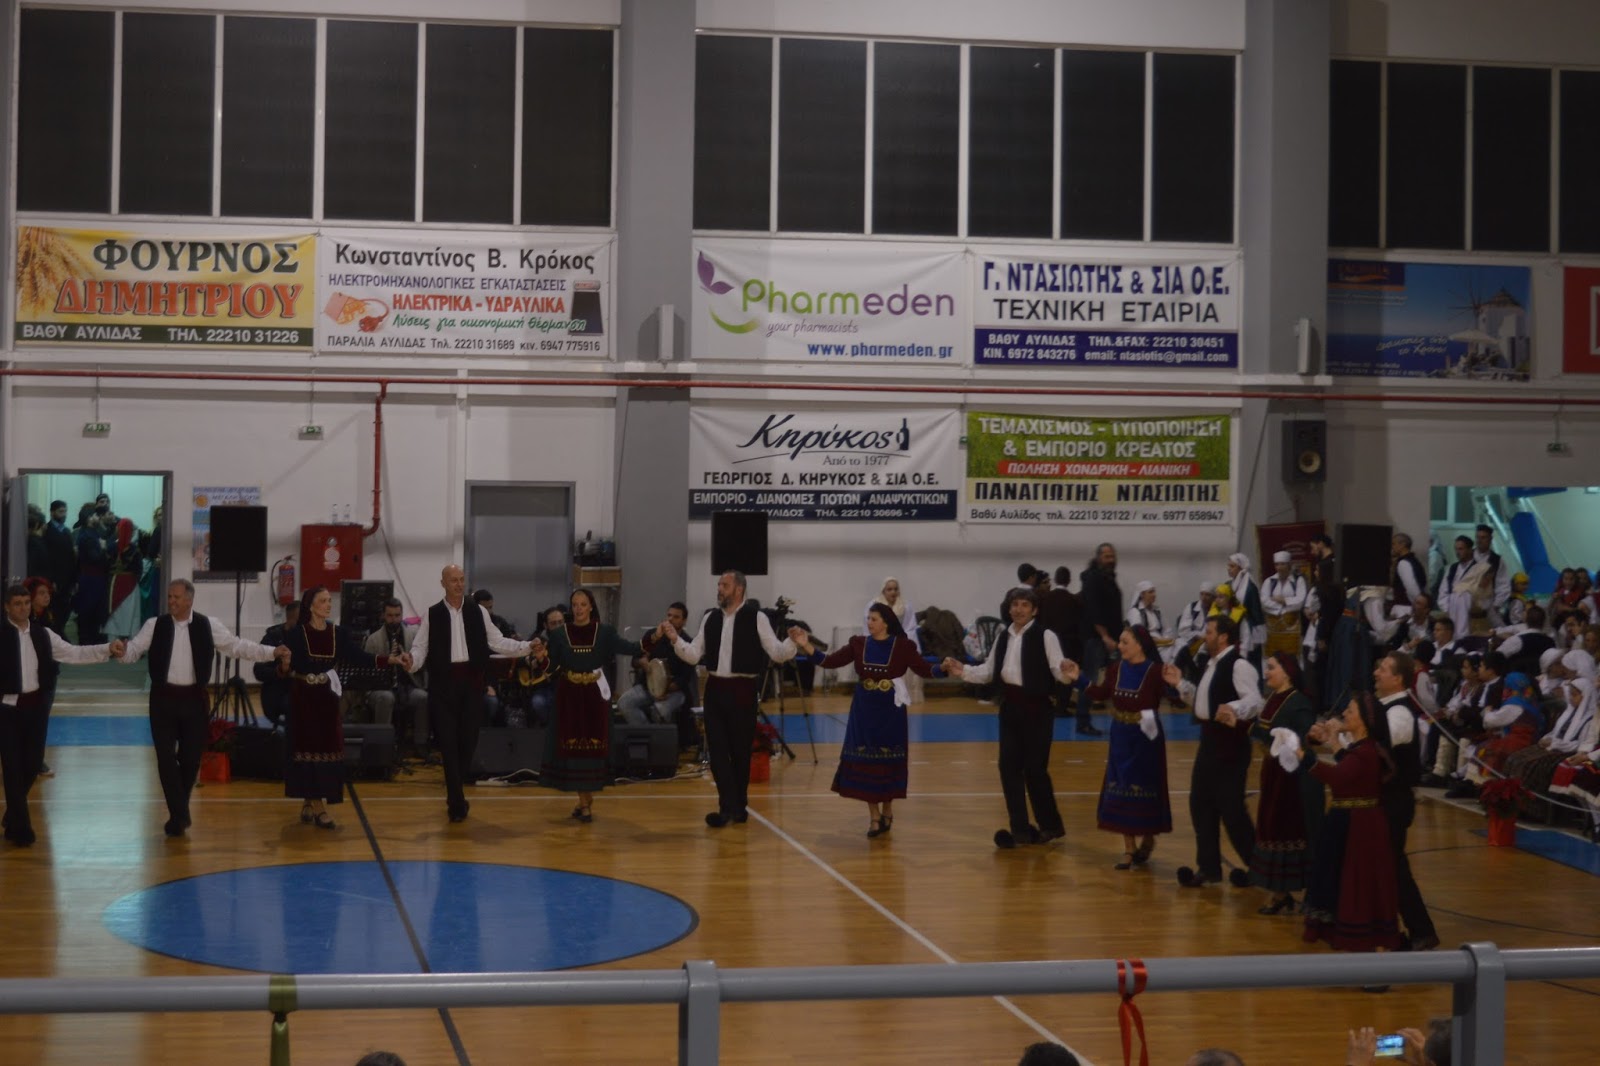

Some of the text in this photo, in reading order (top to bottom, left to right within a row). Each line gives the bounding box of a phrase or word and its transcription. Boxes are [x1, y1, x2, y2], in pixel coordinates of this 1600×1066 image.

[92, 238, 300, 274] ΦΟΥΡΝΟΣ
[335, 243, 595, 274] Κωνσταντίνος Β. Κρόκος
[328, 274, 476, 290] ΗΛΕΚΤΡΟΜΗΧΑΝΟΛΟΓΙΚΕΣ
[481, 278, 567, 291] ΕΓΚΑΤΑΣΤΑΣΕΙΣ
[983, 261, 1230, 295] Γ. ΝΤΑΣΙΩΤΗΣ & ΣΙΑ Ο.Ε.
[54, 277, 304, 318] ΔΗΜΗΤΡΙΟΥ
[393, 294, 473, 312] ΗΛΕΚΤΡΙΚΑ
[486, 296, 565, 313] ΥΔΡΑΥΛΙΚΑ
[742, 278, 955, 316] Pharmeden
[993, 298, 1219, 323] ΤΕΧΝΙΚΗ ΕΤΑΙΡΙΑ
[392, 314, 431, 329] Λύσεις
[437, 316, 457, 331] για
[461, 317, 525, 332] οικονομική
[765, 320, 859, 337] your pharmacists
[22, 324, 300, 343] ΒΑΘΥ ΑΥΛΙΔΑΣ ΤΗΛ. 22210 31226
[988, 334, 1020, 345] ΒΑΘΥ
[1025, 335, 1076, 346] ΑΥΛΙΔΑΣ
[1152, 337, 1187, 347] 22210
[1190, 337, 1224, 348] 30451
[327, 335, 600, 351] ΠΑΡΑΛΙΑ ΑΥΛΙΔΑΣ Τηλ. 22210 31689 κιν. 6947 775916
[807, 343, 954, 358] www.pharmeden.gr
[983, 349, 1076, 360] ΚΙΝ. 6972 843276
[1085, 351, 1229, 362] email: ntasiotis@gmail.com
[979, 418, 1094, 436] ΤΕΜΑΧΙΣΜΟΣ
[1112, 420, 1222, 436] ΤΥΠΟΠΟΙΗΣΗ
[736, 414, 894, 460] Κηρύκος
[1003, 440, 1197, 458] & ΕΜΠΟΡΙΟ ΚΡΕΑΤΟΣ
[822, 456, 847, 466] Από
[864, 456, 890, 466] 1977
[1008, 463, 1060, 475] ΠΩΛΗΣΗ
[1064, 464, 1128, 475] ΧΟΝΔΡΙΚΗ
[1139, 465, 1191, 476] ΛΙΑΝΙΚΗ
[704, 472, 939, 485] ΓΕΩΡΓΙΟΣ Δ. ΚΗΡΥΚΟΣ & ΣΙΑ Ο.Ε.
[693, 492, 747, 504] ΕΜΠΟΡΙΟ
[755, 493, 815, 505] ΔΙΑΝΟΜΕΣ
[820, 493, 860, 505] ΠΟΤΩΝ
[868, 494, 948, 505] ΑΝΑΨΥΚΤΙΚΩΝ
[975, 482, 1220, 502] ΠΑΝΑΓΙΩΤΗΣ ΝΤΑΣΙΩΤΗΣ
[840, 509, 871, 517] 22210
[971, 508, 997, 519] Βαθύ
[999, 508, 1041, 521] Αυλίδος
[1046, 510, 1065, 520] τηλ.
[1068, 510, 1098, 520] 22210
[1101, 510, 1130, 520] 32122
[1162, 511, 1186, 521] 6977
[1188, 511, 1224, 521] 658947
